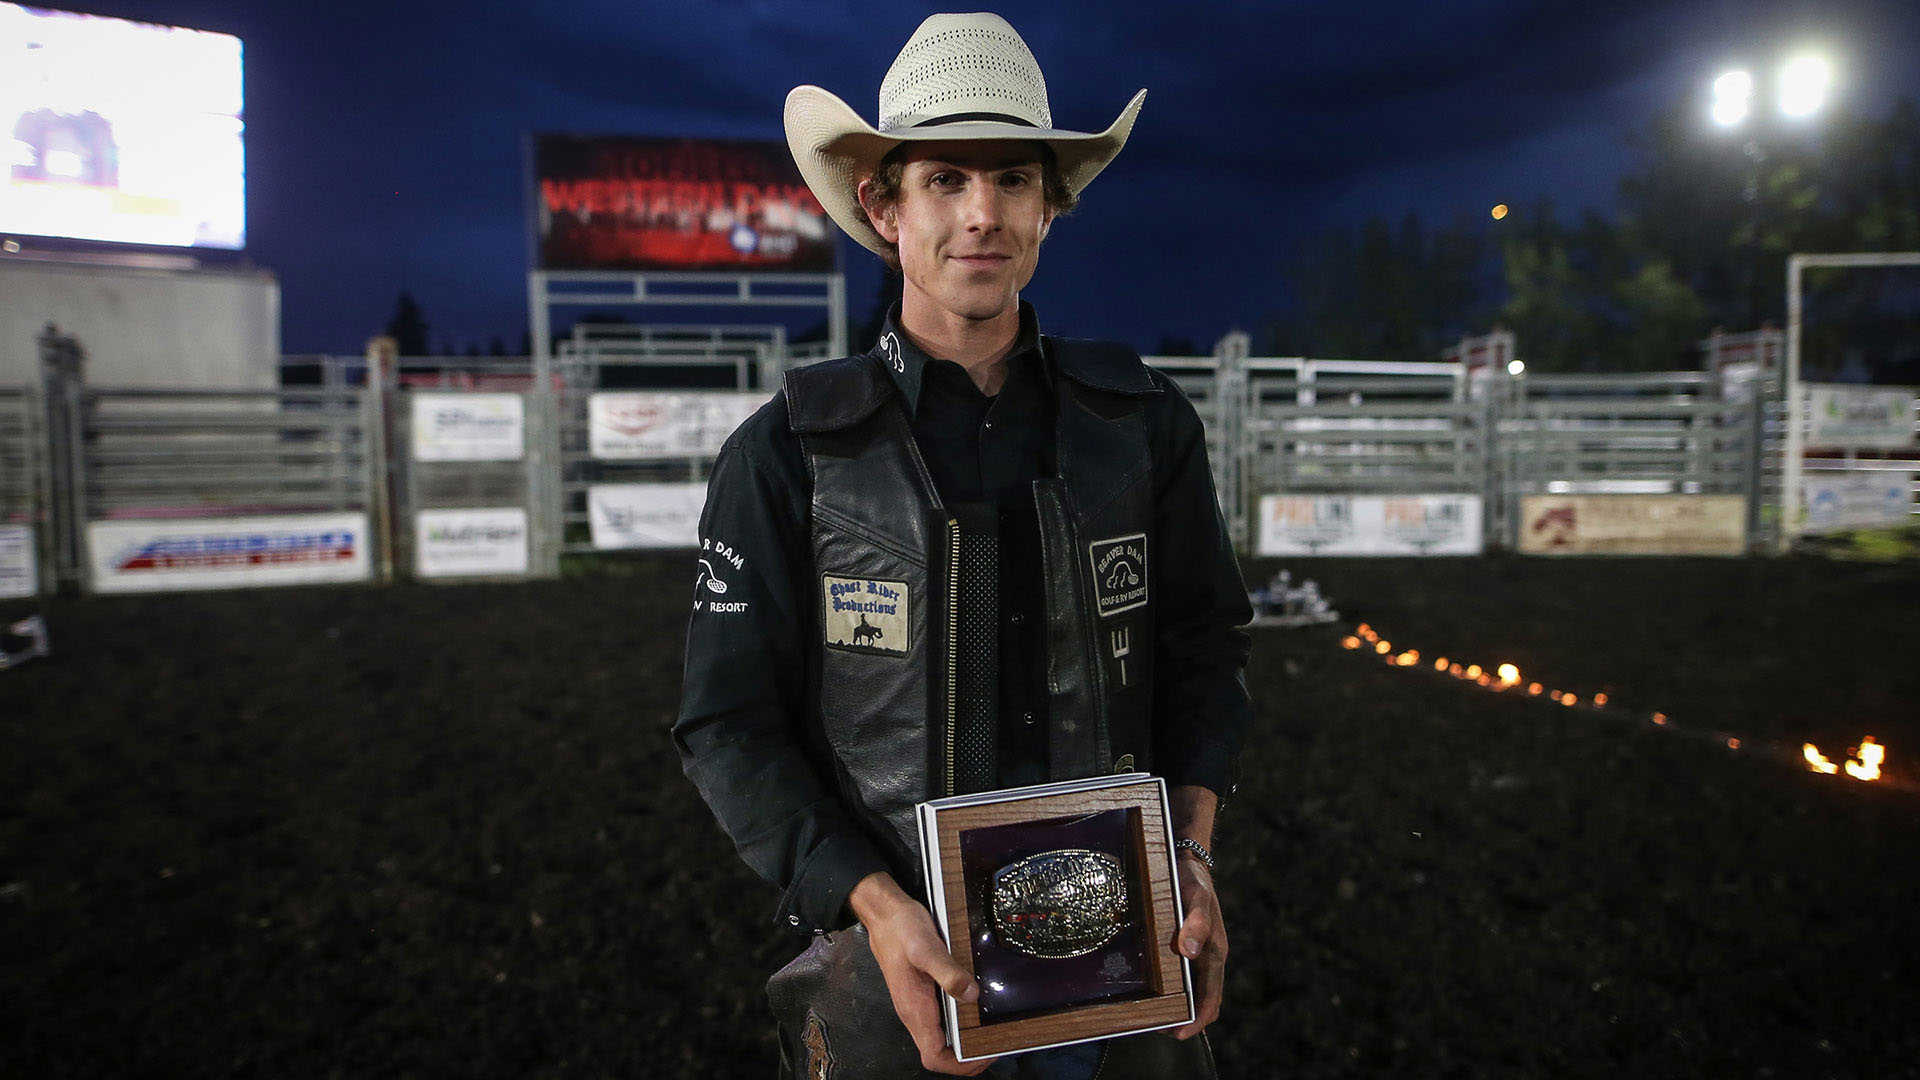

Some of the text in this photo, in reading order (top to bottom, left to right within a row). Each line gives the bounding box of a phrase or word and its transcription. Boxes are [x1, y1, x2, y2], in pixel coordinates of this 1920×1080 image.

[541, 179, 724, 213] WESTERN
[715, 541, 744, 570] DAM
[1098, 545, 1143, 573] BEAVER DAM
[830, 581, 900, 601] Ghost Rider
[710, 602, 748, 613] RESORT
[833, 597, 897, 616] Productions
